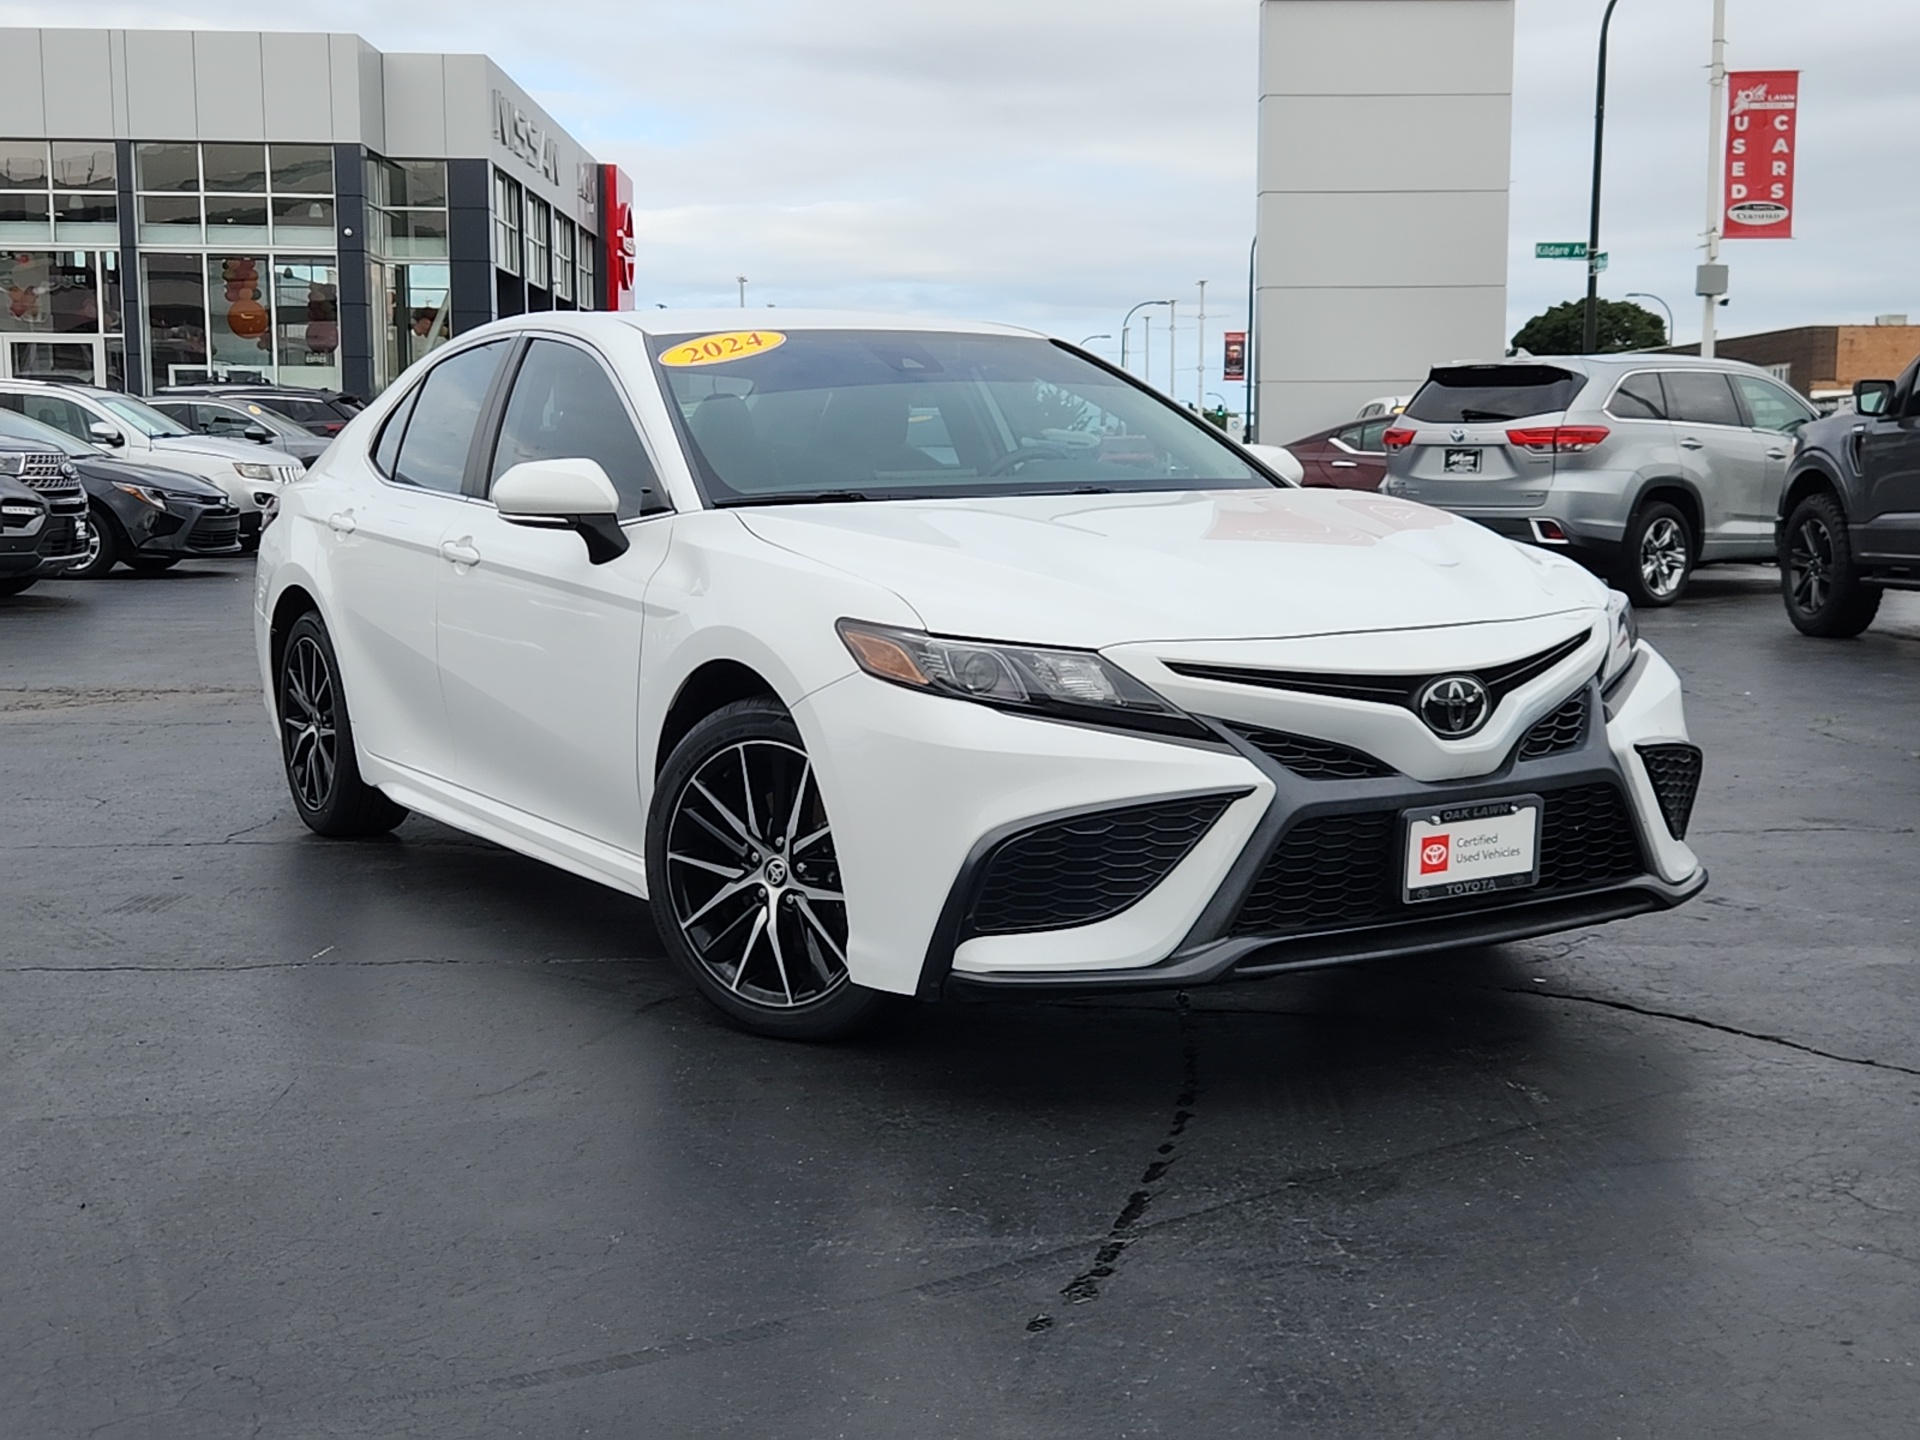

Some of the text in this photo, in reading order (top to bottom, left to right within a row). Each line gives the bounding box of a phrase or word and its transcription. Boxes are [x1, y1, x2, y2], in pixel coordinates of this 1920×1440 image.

[491, 88, 560, 187] NISSAN
[1731, 115, 1750, 200] USED
[1770, 114, 1789, 200] CARS
[1536, 244, 1570, 257] Kildare
[681, 332, 764, 364] 2024
[1443, 803, 1509, 821] OAK LAWN
[1456, 832, 1499, 848] Certified
[1455, 845, 1521, 864] Used Vehicles
[1446, 879, 1497, 895] TOYOTA
